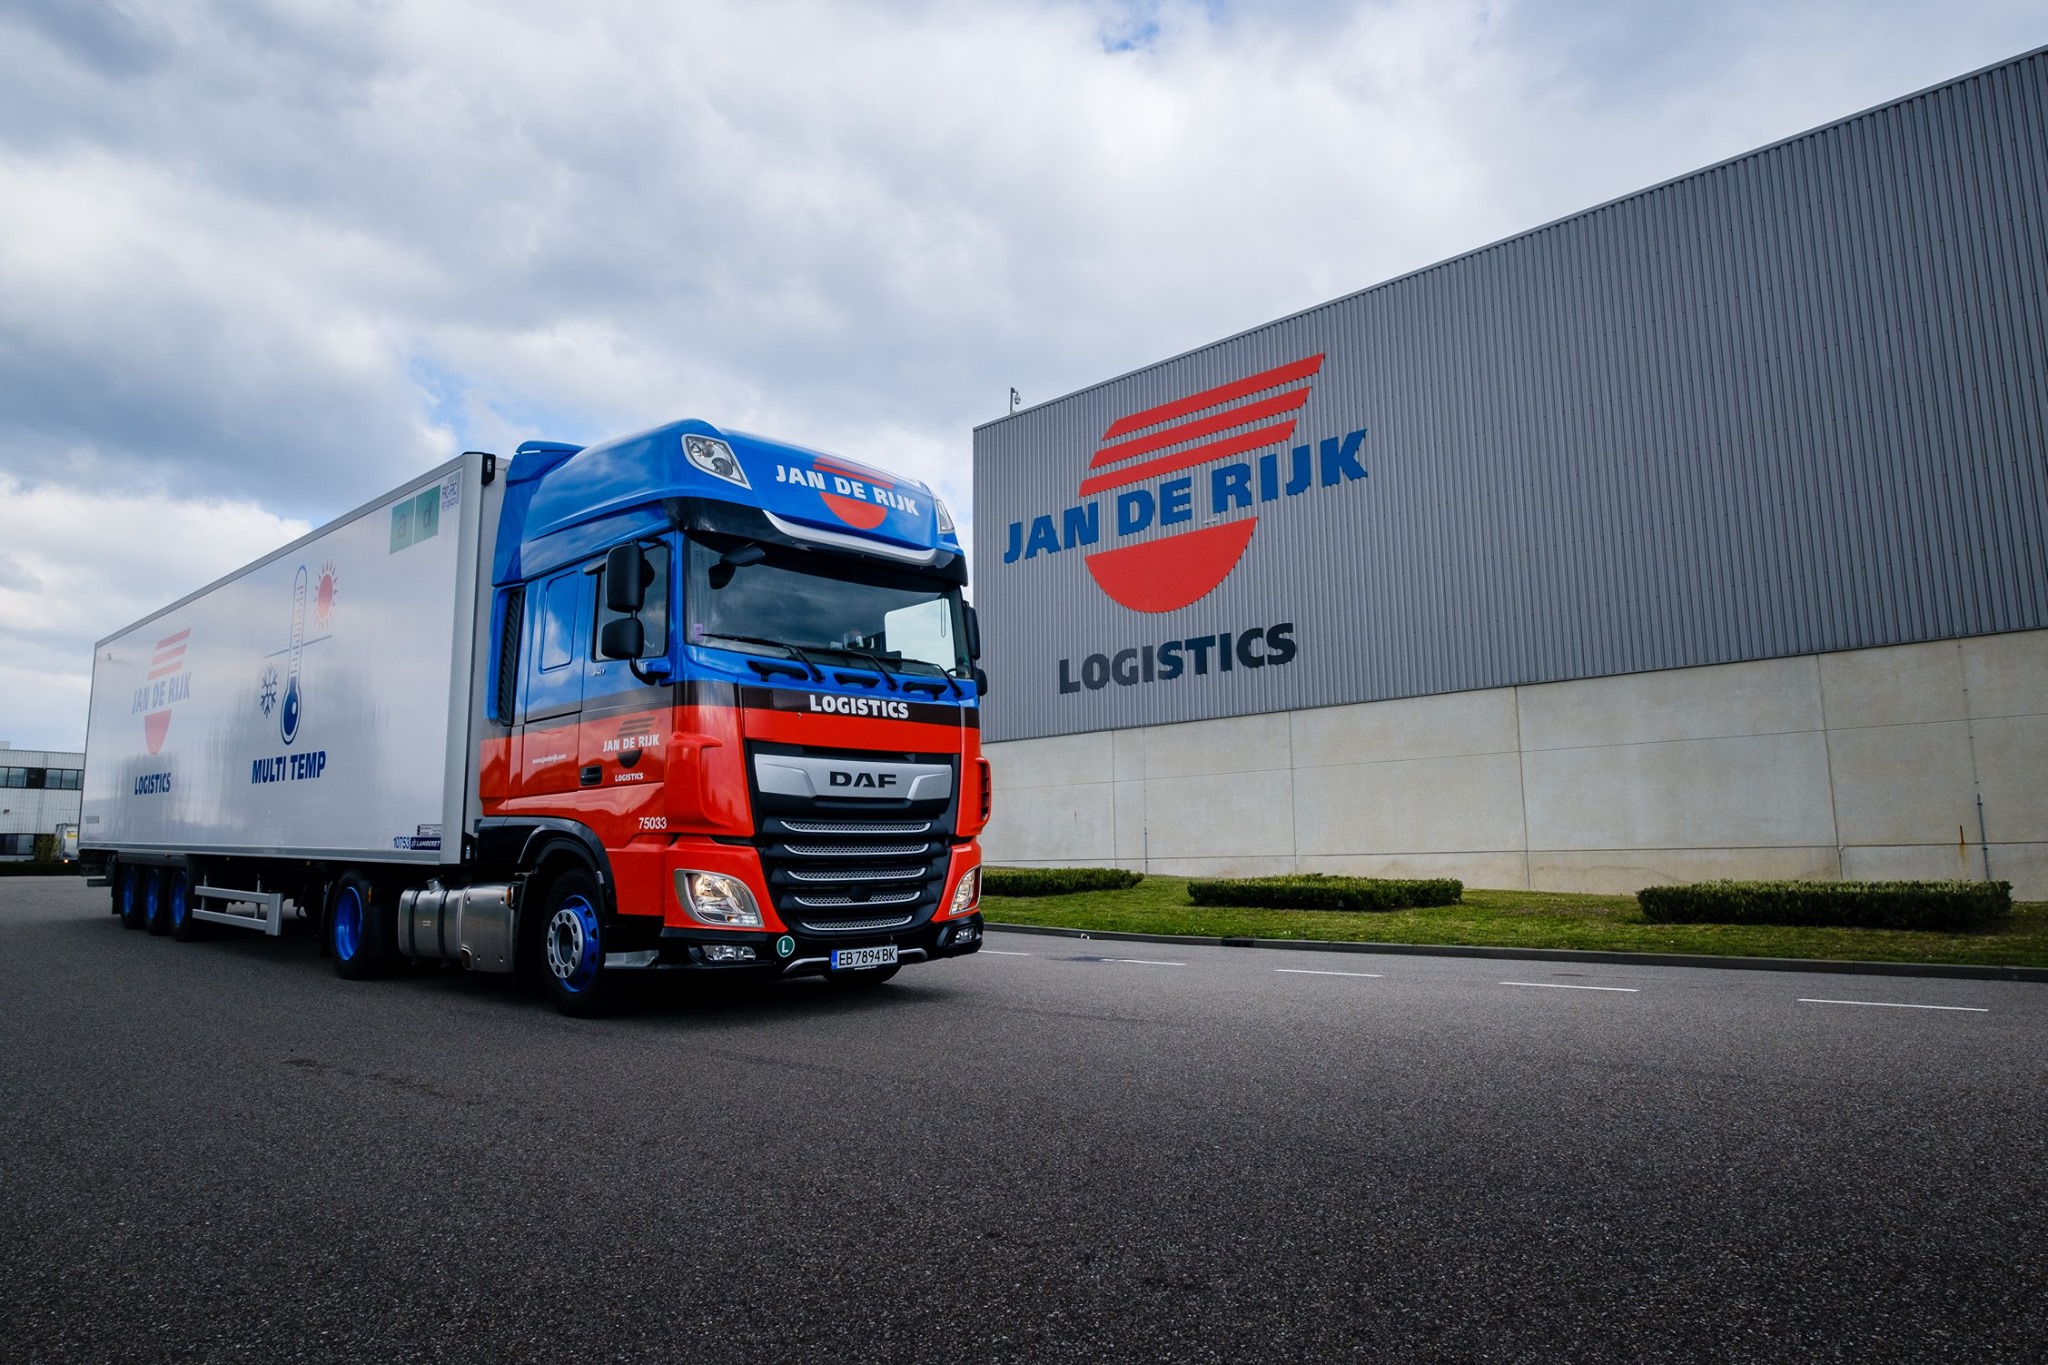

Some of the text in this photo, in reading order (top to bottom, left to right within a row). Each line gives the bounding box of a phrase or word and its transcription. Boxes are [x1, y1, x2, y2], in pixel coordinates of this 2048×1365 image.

[776, 464, 919, 516] JAN DE RIJK
[1004, 429, 1368, 564] JAN DE RIJK
[423, 501, 432, 528] d
[1058, 623, 1297, 695] LOGISTICS
[131, 672, 192, 714] JAN DE RIJK
[809, 694, 909, 719] LOGISTICS
[603, 734, 660, 752] JAN DE RIJK
[251, 751, 326, 784] MULTI TEMP
[615, 772, 644, 782] LOGISTICS
[829, 771, 897, 788] DAF
[134, 772, 171, 795] LOGISTICS
[639, 816, 667, 829] 75033
[781, 940, 789, 953] L
